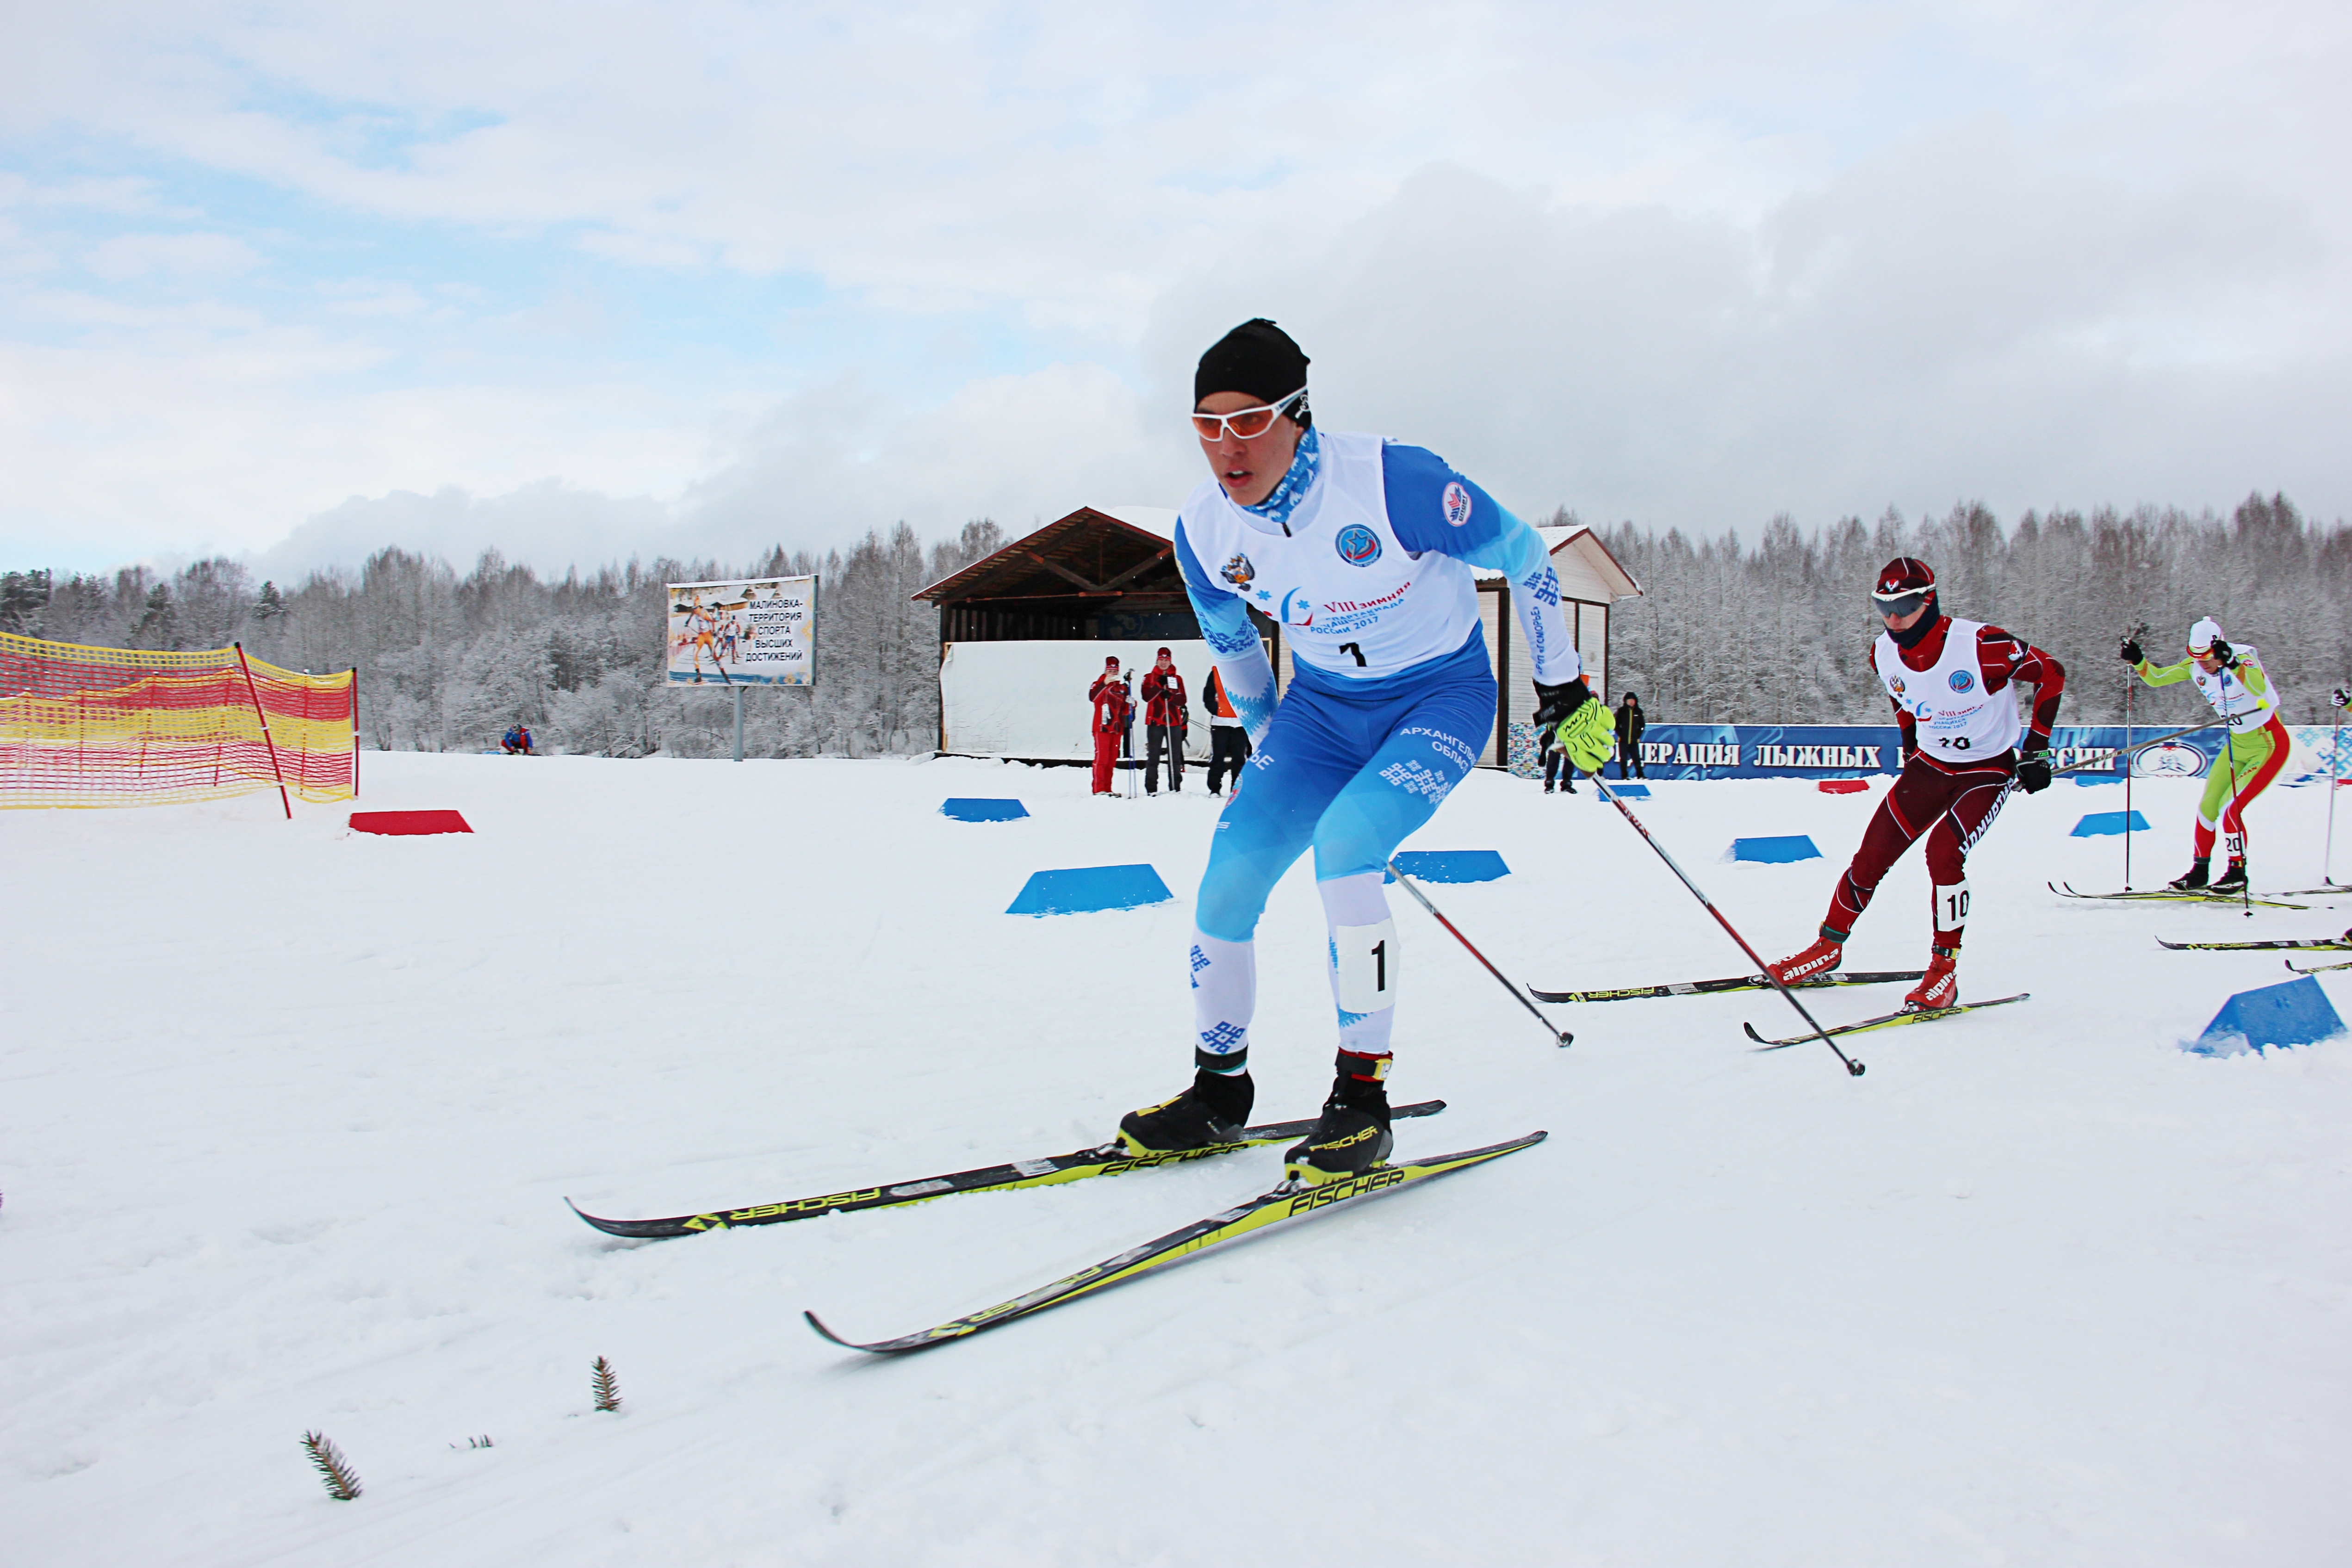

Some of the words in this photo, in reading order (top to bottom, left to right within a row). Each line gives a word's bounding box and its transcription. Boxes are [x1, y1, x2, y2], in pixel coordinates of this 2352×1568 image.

[749, 599, 803, 609] МАЛИНОВКА-
[1323, 601, 1358, 613] VIII
[1359, 581, 1411, 609] ЗИМНЯЯ
[748, 612, 802, 622] ТЕРРИТОРИЯ
[1353, 616, 1379, 629] 2017
[757, 626, 791, 635] СПОРТА
[755, 639, 793, 648] ВЫСШИХ
[745, 650, 802, 663] ДОСТИЖЕНИЙ
[1753, 745, 1882, 768] ЛЫЖНЫХ
[2225, 837, 2240, 852] 20
[1947, 890, 1969, 921] 10
[1371, 940, 1385, 992] 1
[1783, 948, 1839, 981] alpina
[1588, 987, 1655, 998] FISCHER
[1911, 1008, 1962, 1023] FISCHER
[1309, 1126, 1378, 1152] FISCHER
[1288, 1170, 1404, 1217] FISCHER
[729, 1187, 881, 1221] FISCHER
